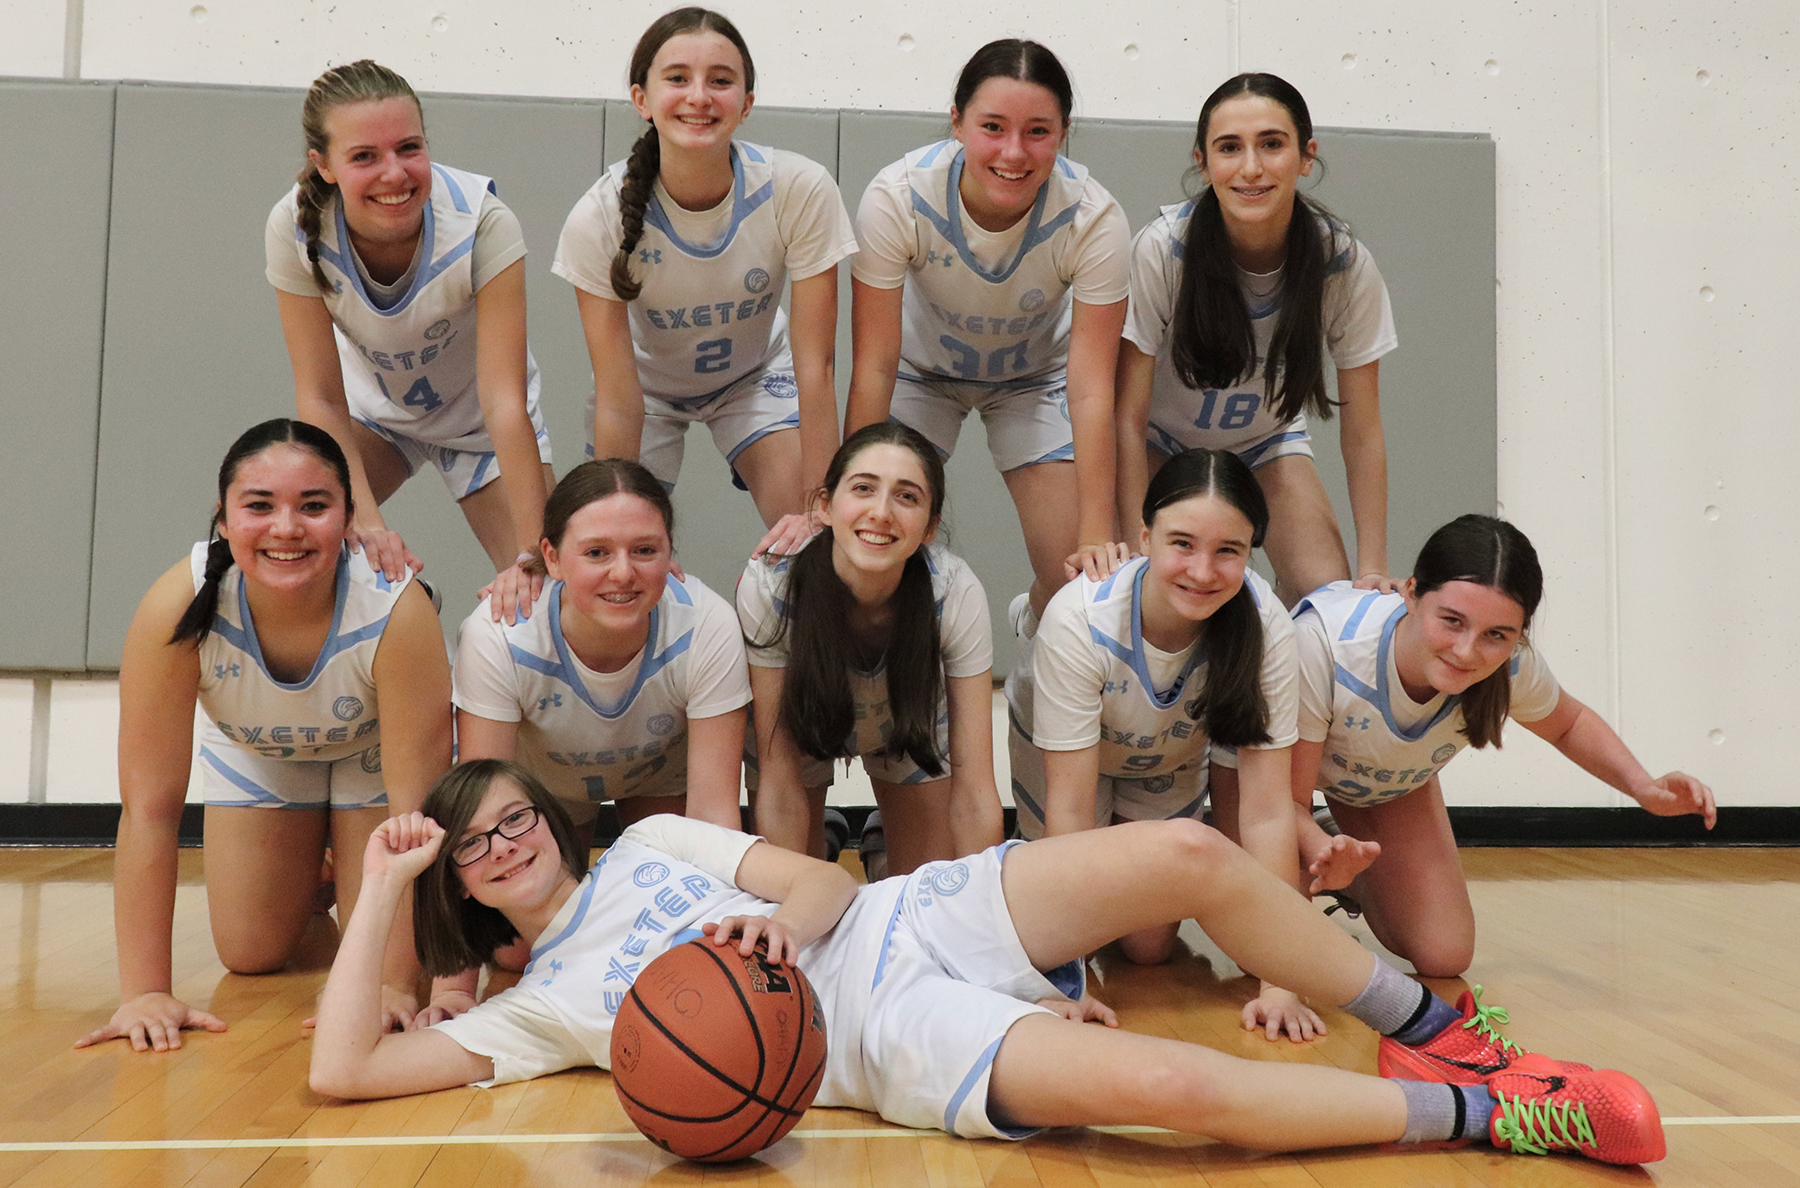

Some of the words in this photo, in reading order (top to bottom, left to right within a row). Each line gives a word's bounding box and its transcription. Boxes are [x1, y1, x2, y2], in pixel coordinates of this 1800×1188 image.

[647, 292, 773, 330] EXETER
[694, 337, 733, 374] 2
[1194, 389, 1262, 430] 18
[1332, 753, 1433, 784] EXETE
[603, 874, 718, 1015] EXETER
